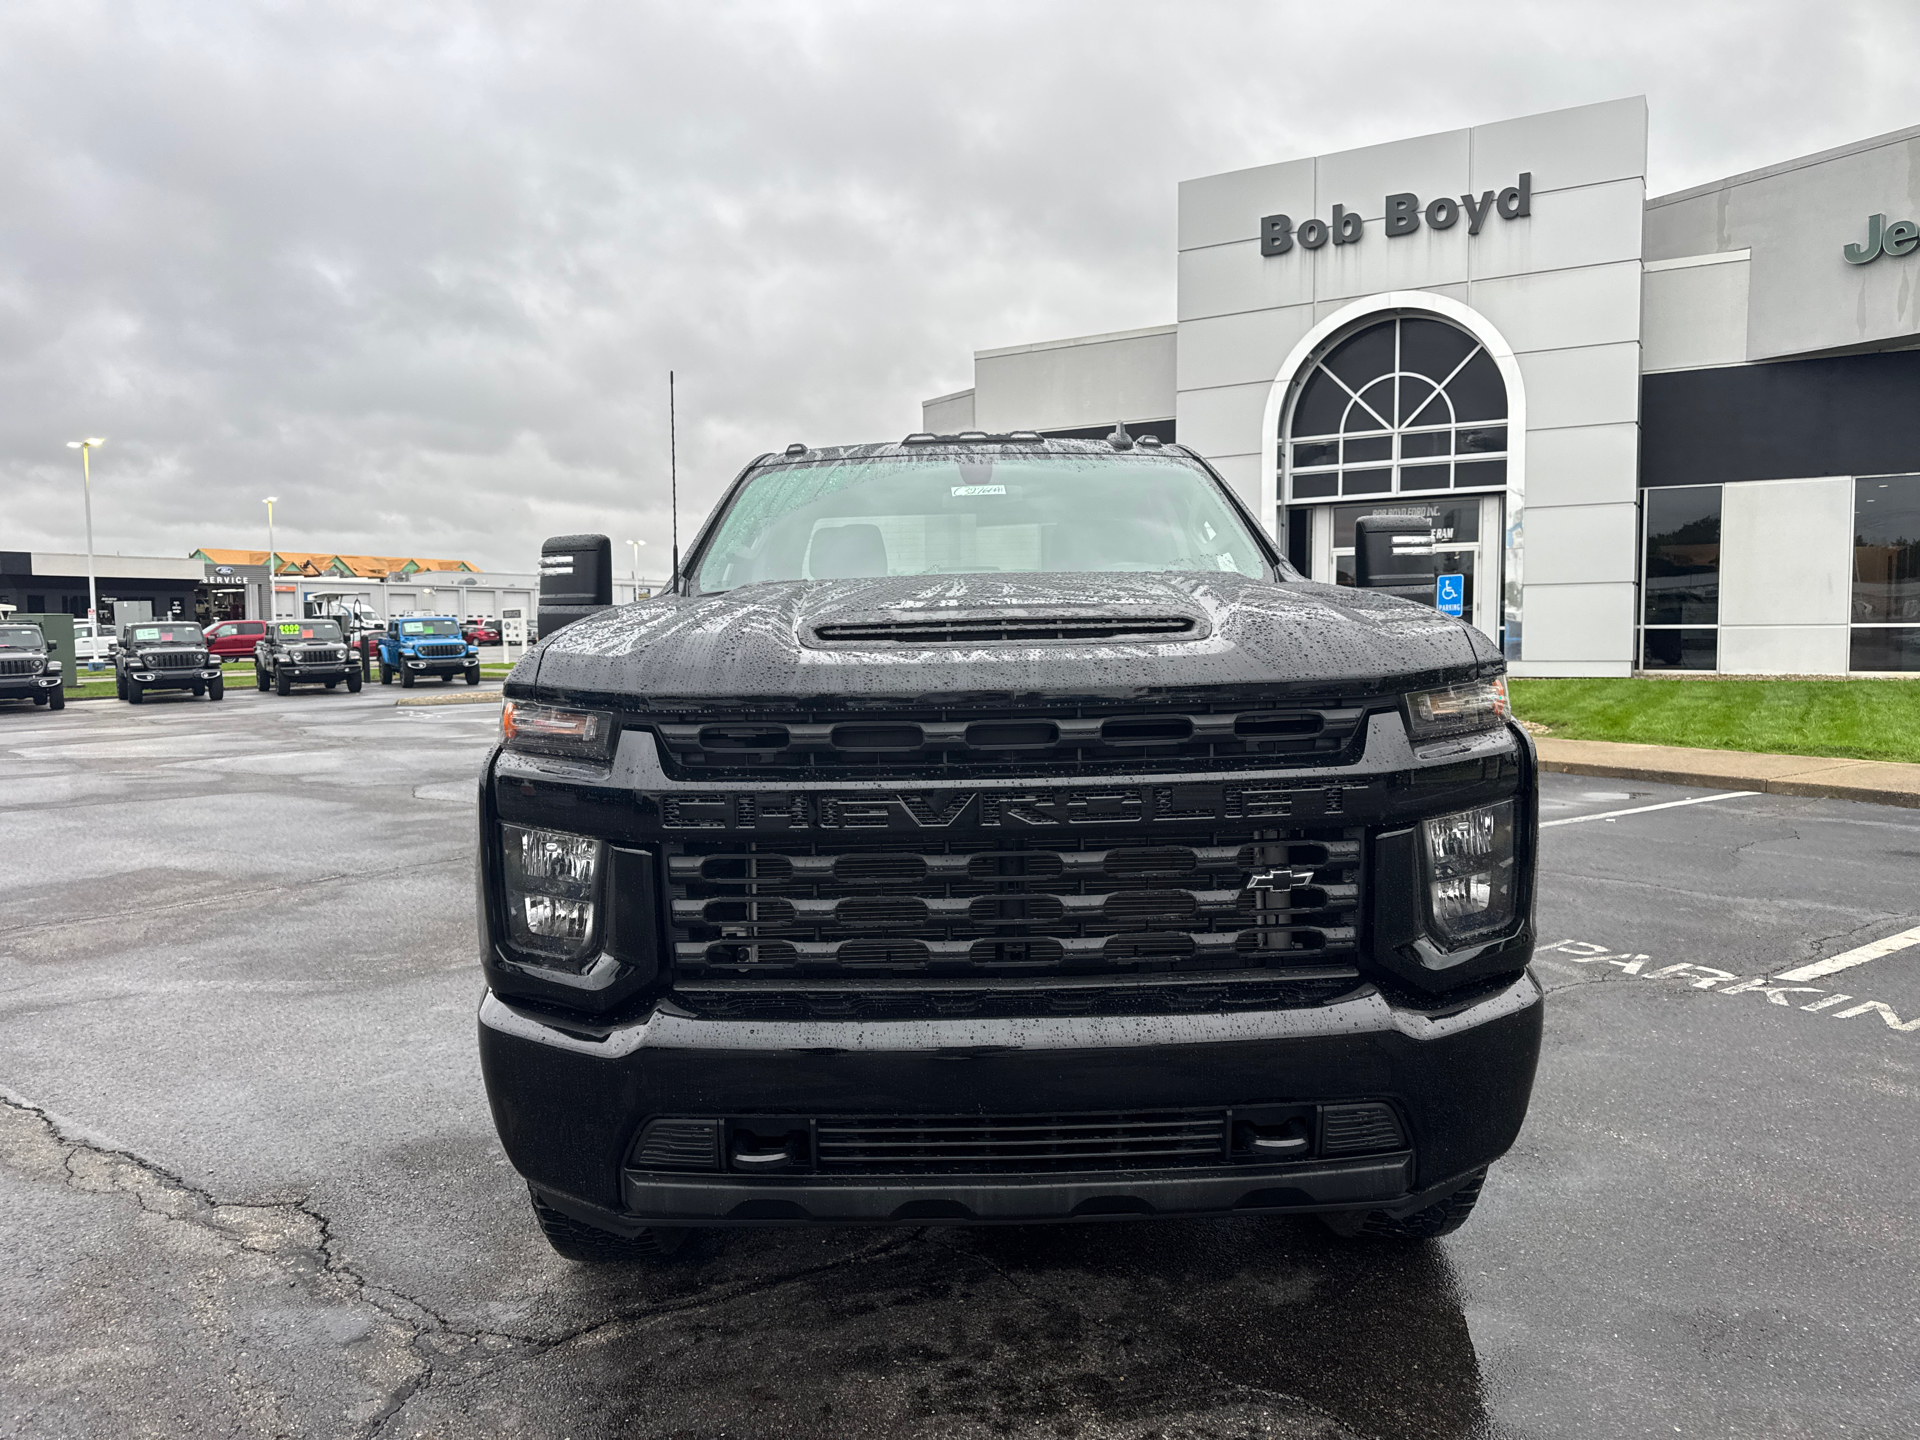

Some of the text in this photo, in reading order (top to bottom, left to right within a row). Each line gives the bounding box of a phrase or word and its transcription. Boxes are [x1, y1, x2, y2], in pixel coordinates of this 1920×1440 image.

[1260, 172, 1531, 258] Bob Boyd
[1843, 213, 1920, 265] Je
[1436, 528, 1454, 539] RAM
[202, 576, 249, 584] SERVICE
[661, 783, 1370, 830] CHEVROLET
